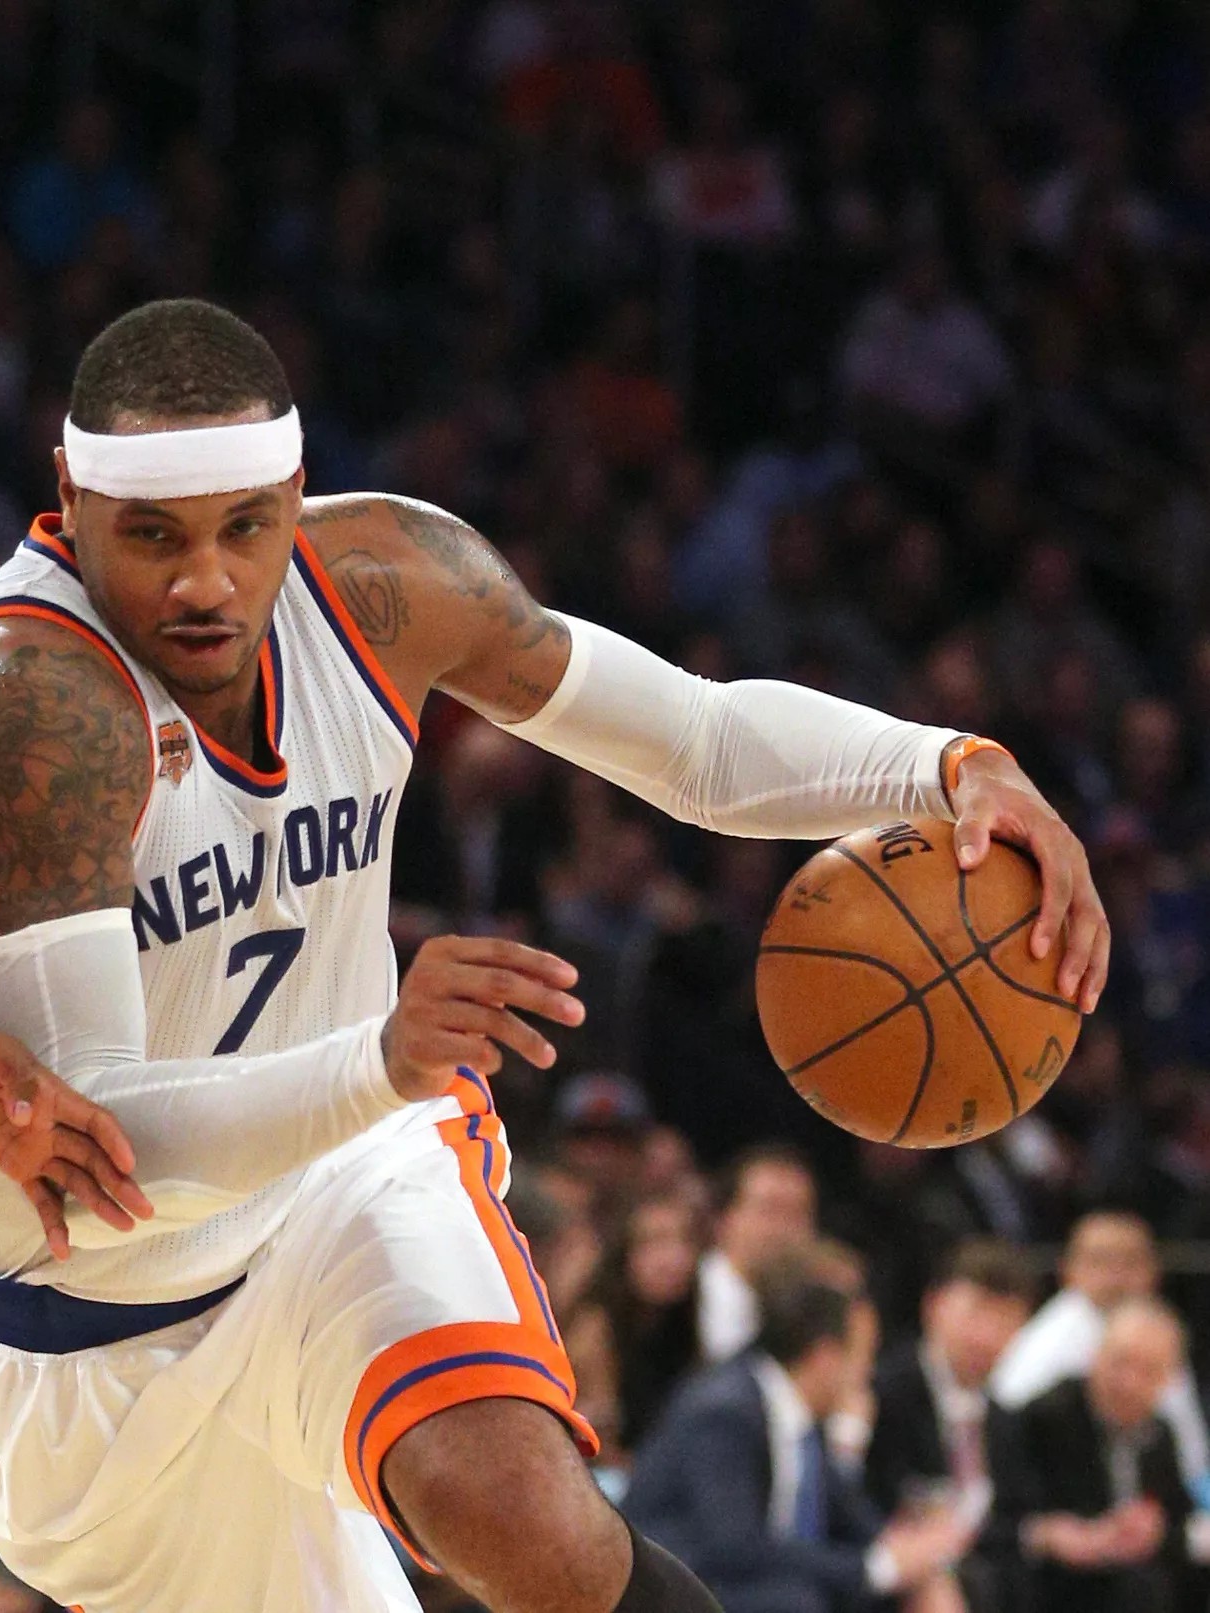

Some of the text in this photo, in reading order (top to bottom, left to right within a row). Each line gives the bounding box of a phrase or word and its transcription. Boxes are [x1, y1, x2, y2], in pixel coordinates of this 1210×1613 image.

[132, 787, 393, 952] NEW ORK
[212, 927, 306, 1056] 7
